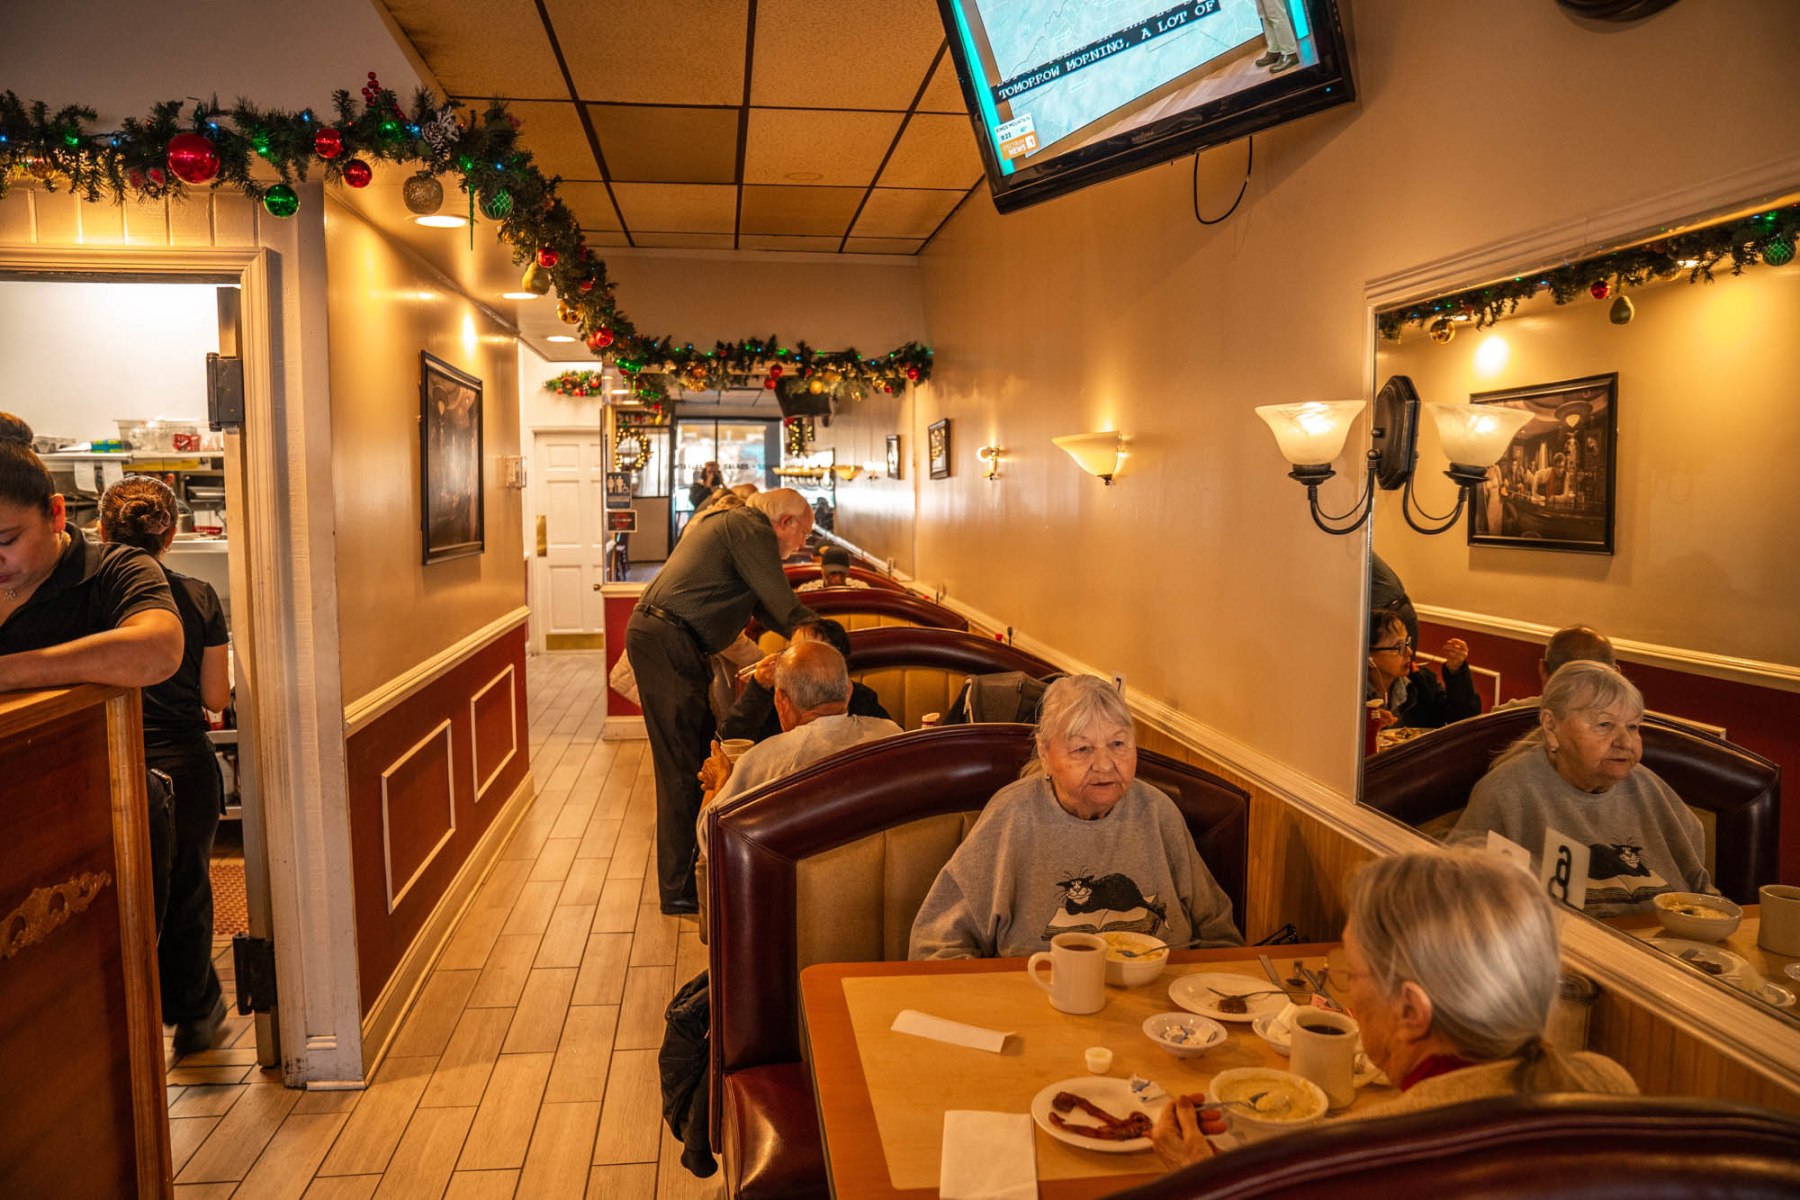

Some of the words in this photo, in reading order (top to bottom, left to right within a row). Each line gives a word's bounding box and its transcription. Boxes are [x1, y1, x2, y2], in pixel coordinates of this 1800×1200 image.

[998, 65, 1060, 99] TOMORROW
[1065, 38, 1130, 72] MORNING,
[1141, 28, 1152, 40] A
[1157, 10, 1188, 32] LOT
[1194, 0, 1216, 16] OF
